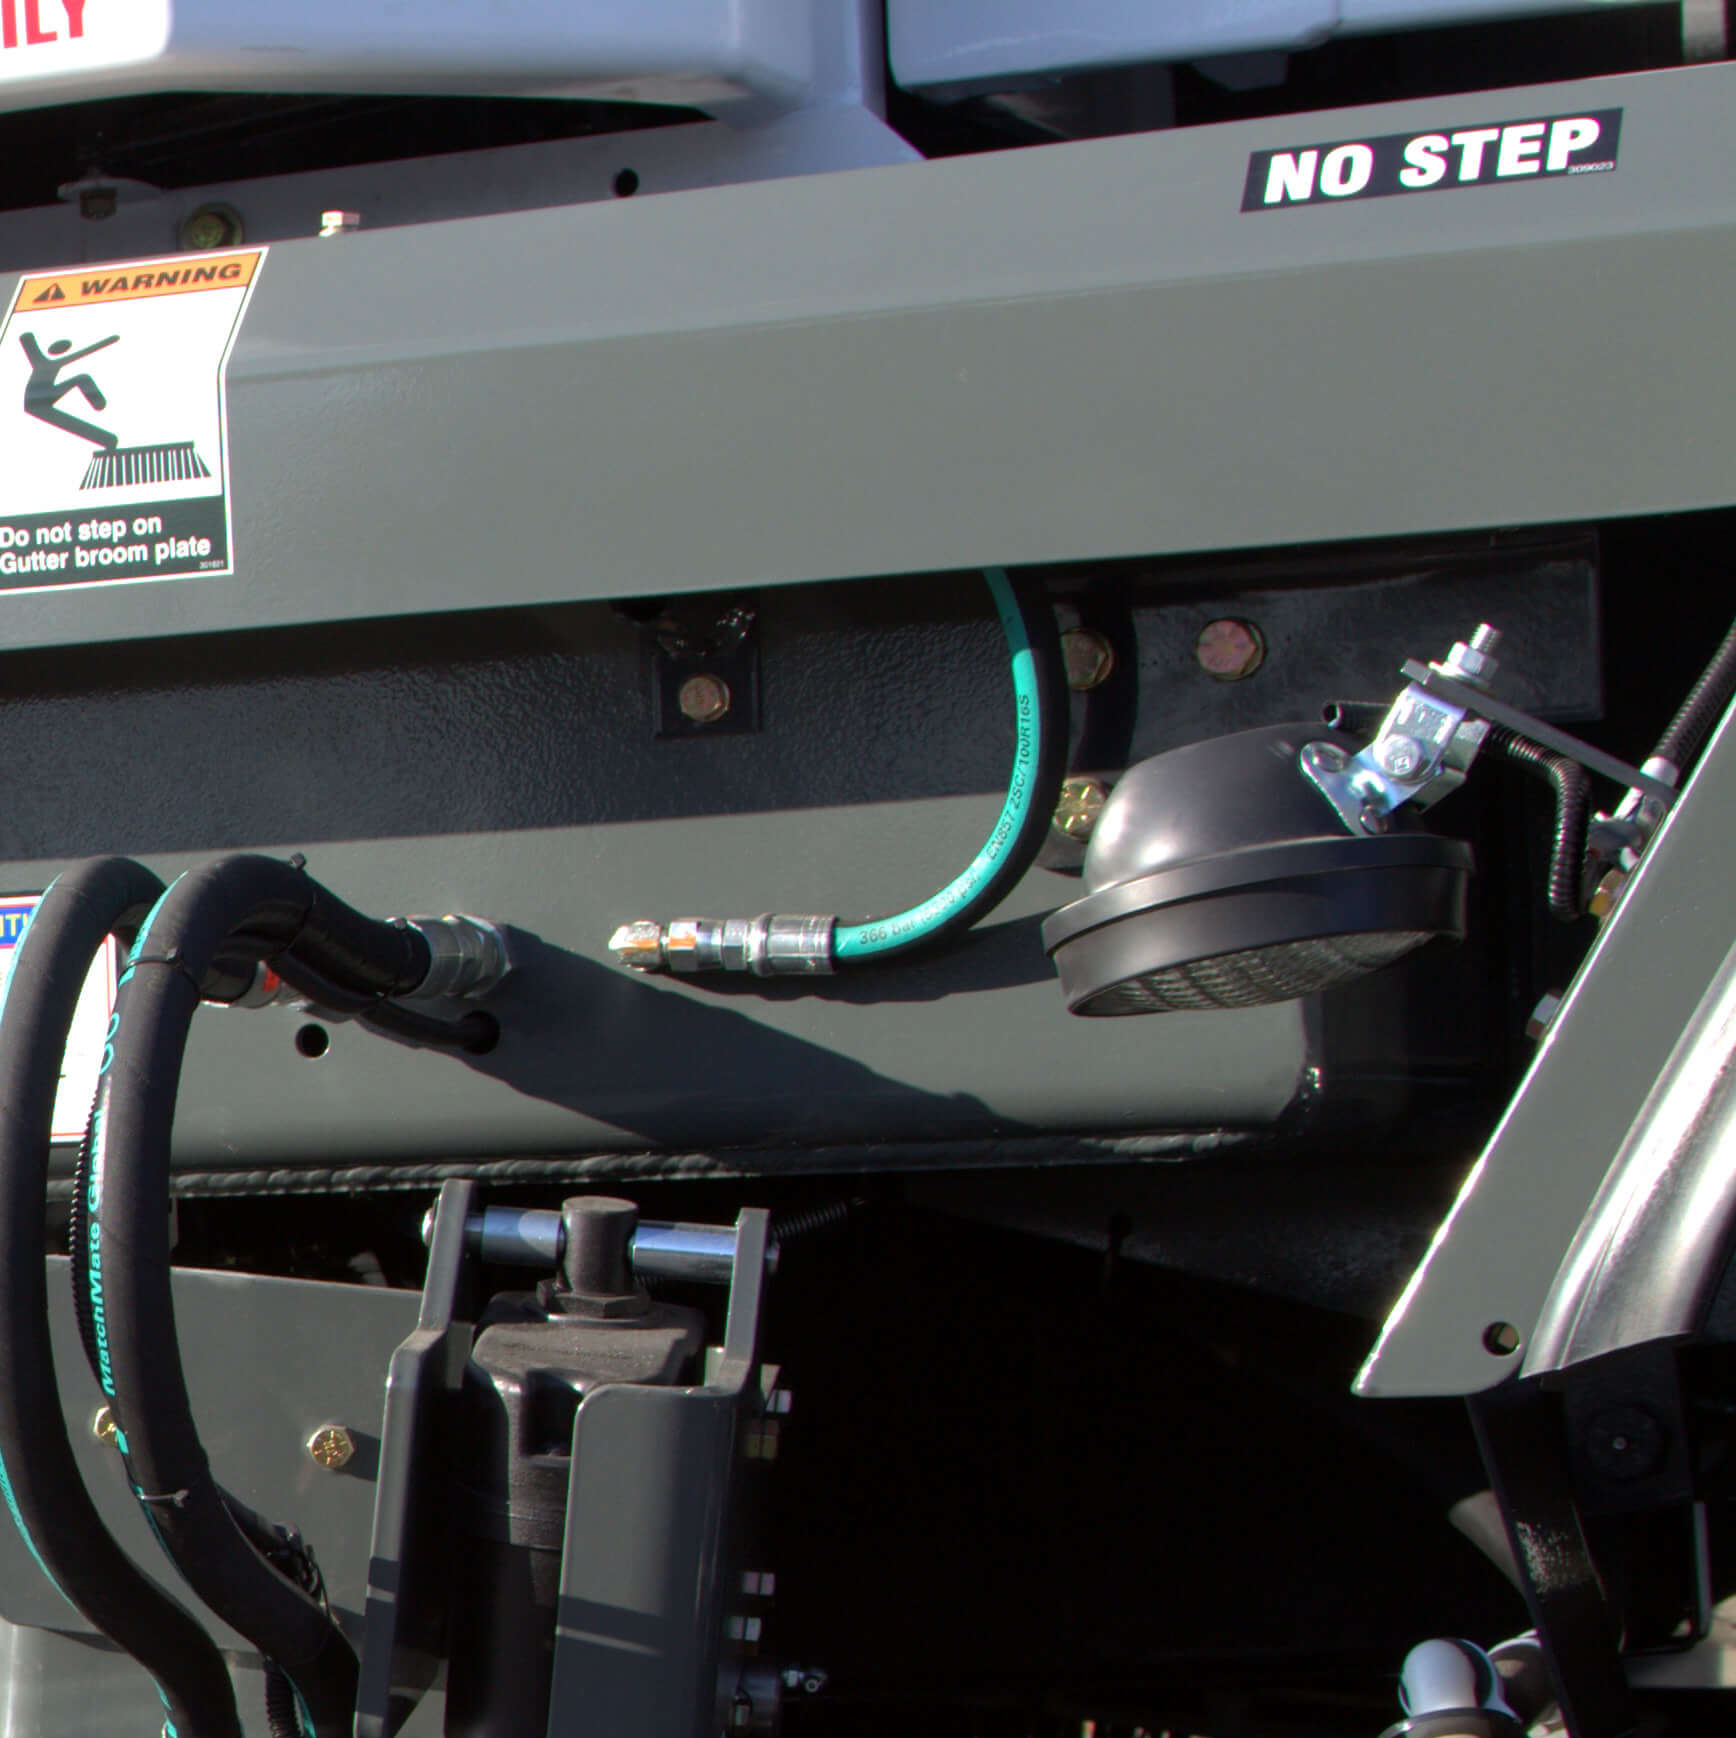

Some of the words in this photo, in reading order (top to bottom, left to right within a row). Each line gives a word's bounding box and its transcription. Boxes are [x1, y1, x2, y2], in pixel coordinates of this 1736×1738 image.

[1264, 144, 1373, 204] NO
[1399, 117, 1601, 188] STEP
[81, 263, 242, 297] WARNING
[36, 521, 71, 545] not
[78, 517, 127, 546] step
[133, 514, 162, 535] on
[0, 549, 69, 575] Gutter
[74, 543, 148, 568] broom
[155, 536, 211, 565] plate
